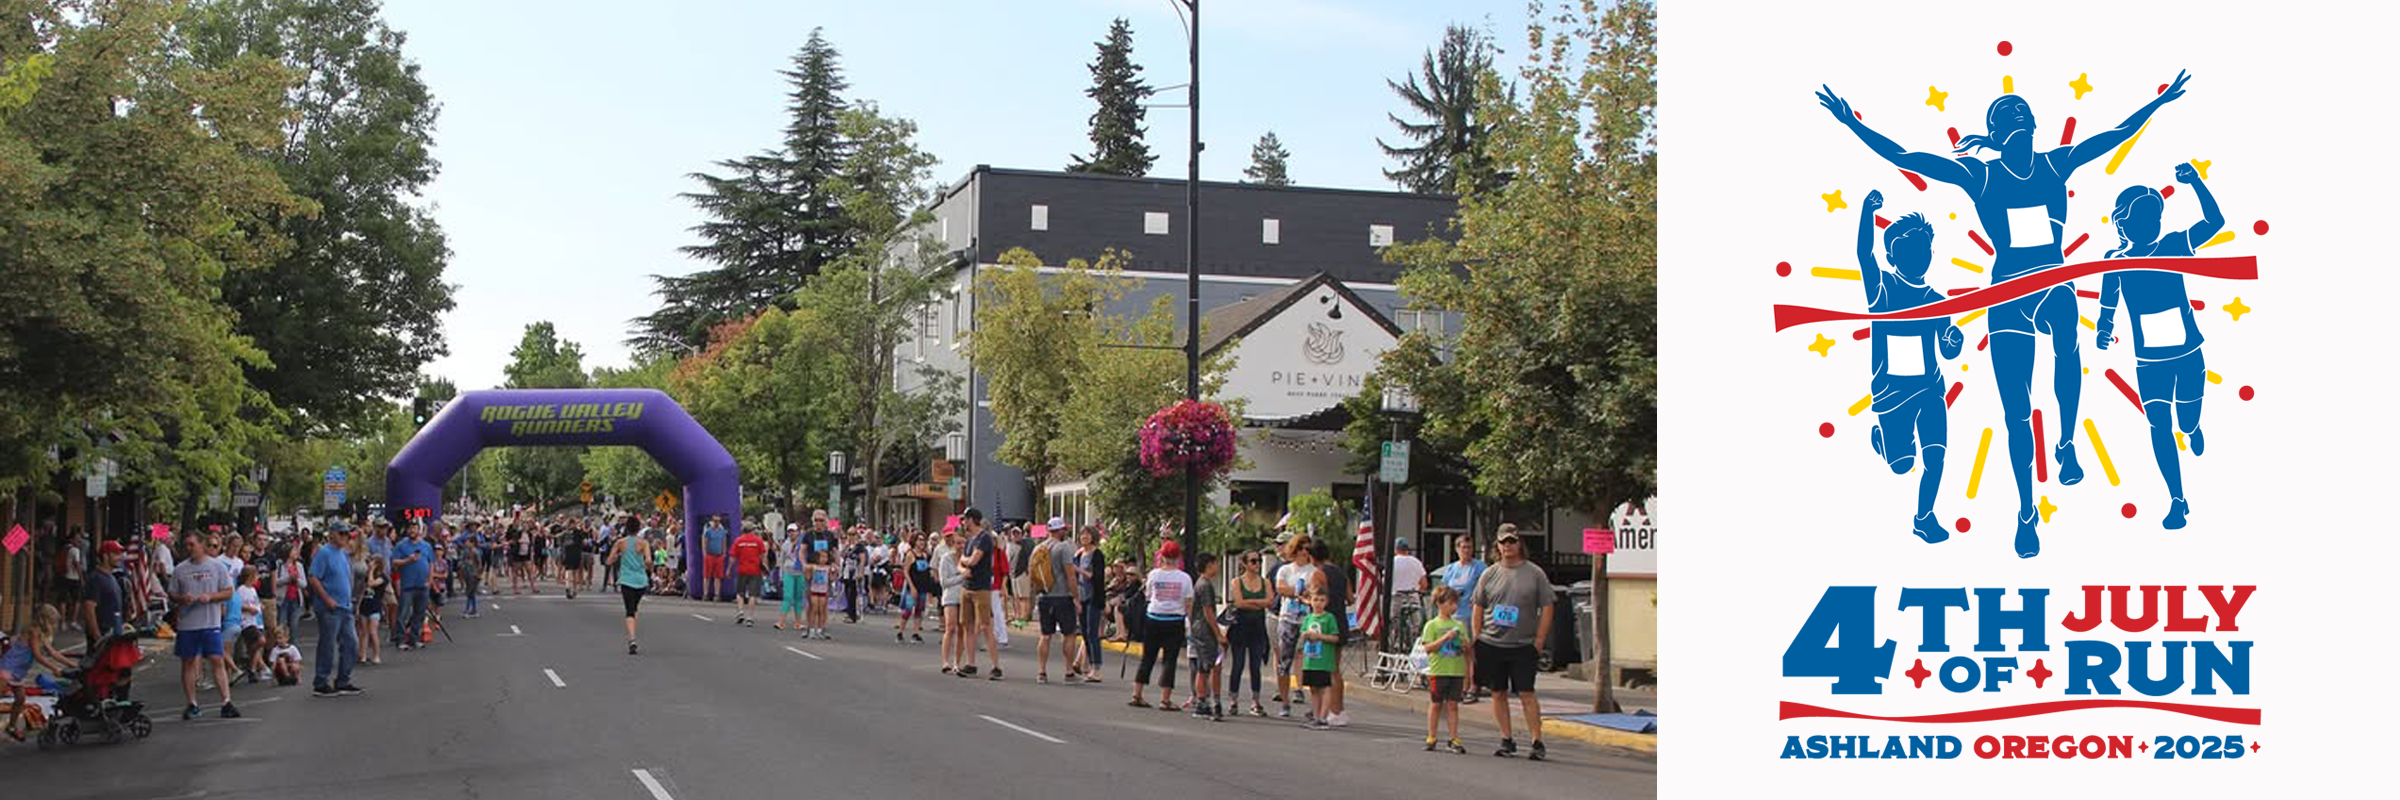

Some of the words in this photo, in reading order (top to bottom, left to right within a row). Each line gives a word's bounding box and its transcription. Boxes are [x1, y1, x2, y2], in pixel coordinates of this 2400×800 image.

[1271, 370, 1305, 386] PIE
[481, 404, 555, 422] ROGUE
[561, 403, 643, 420] VALLEY
[512, 419, 613, 436] RUNNERS
